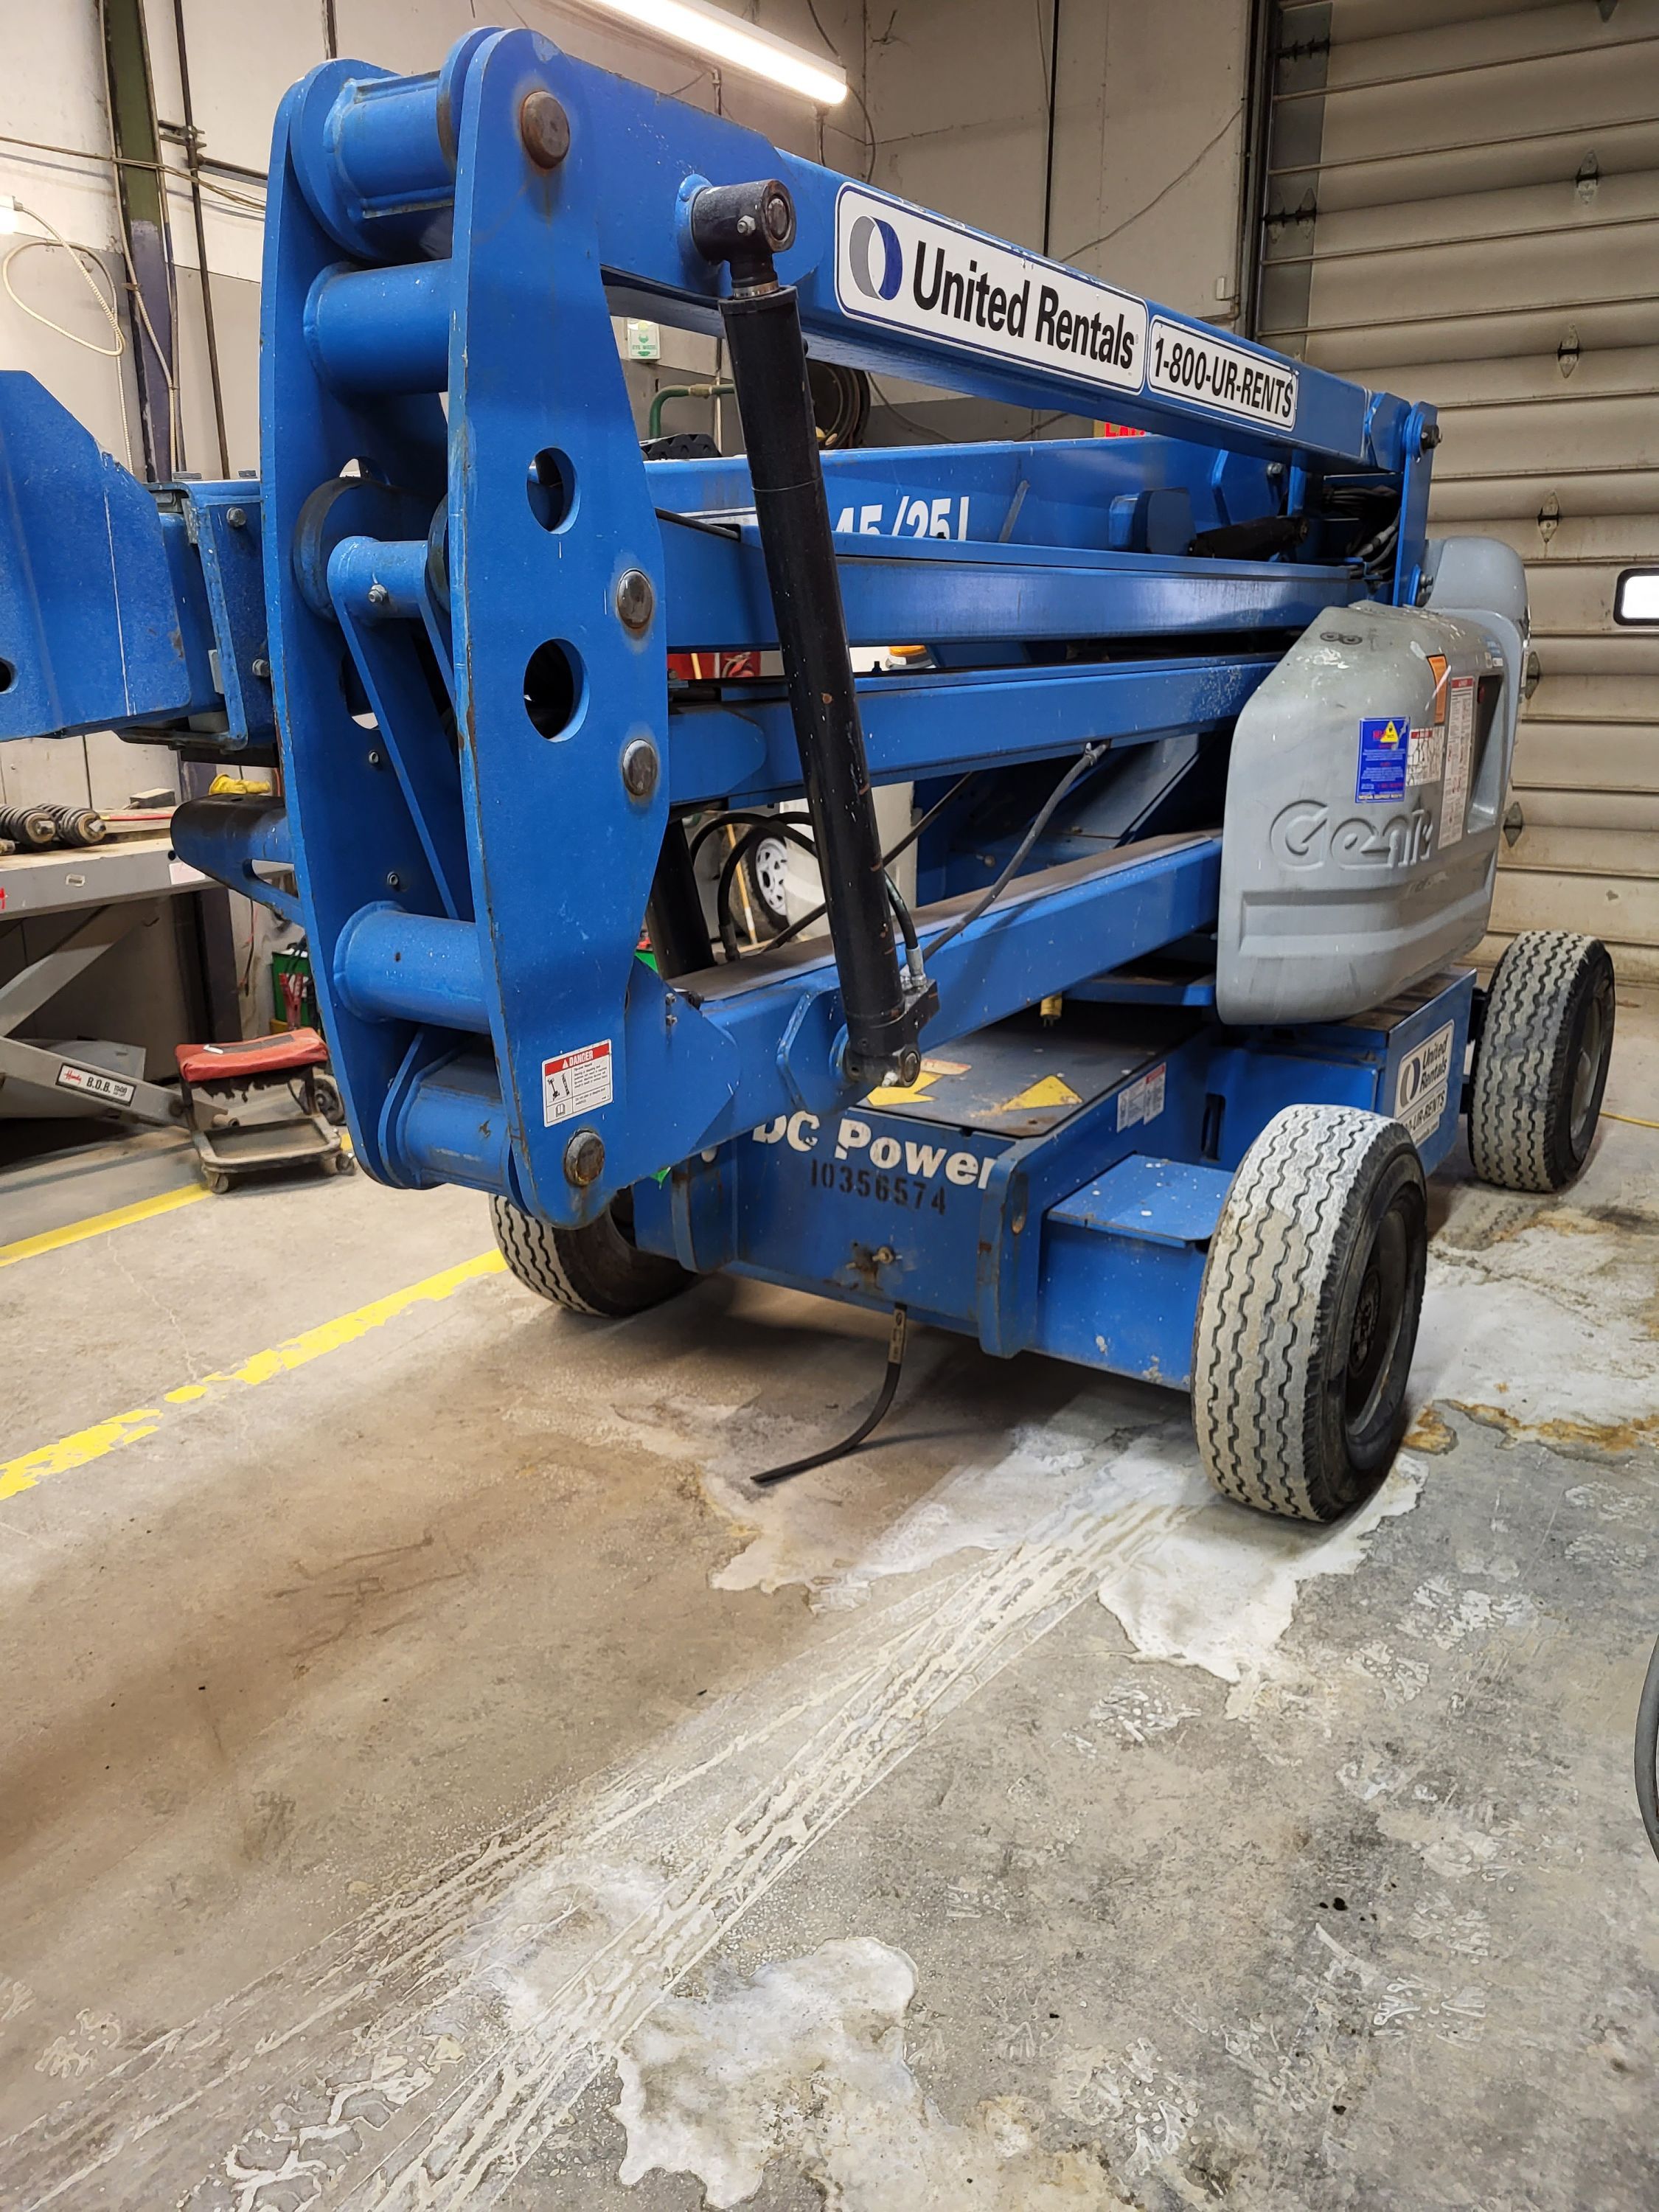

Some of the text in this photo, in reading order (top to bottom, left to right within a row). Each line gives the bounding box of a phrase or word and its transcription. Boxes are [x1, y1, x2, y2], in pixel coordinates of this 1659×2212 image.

[913, 240, 1135, 369] United Rentals
[1155, 337, 1294, 418] 1-800-UR-RENTS
[568, 1050, 594, 1066] DANGER
[1422, 1033, 1449, 1069] United
[86, 1077, 111, 1093] B.O.B.
[1419, 1056, 1447, 1093] Rentals
[811, 1158, 946, 1215] 10356574
